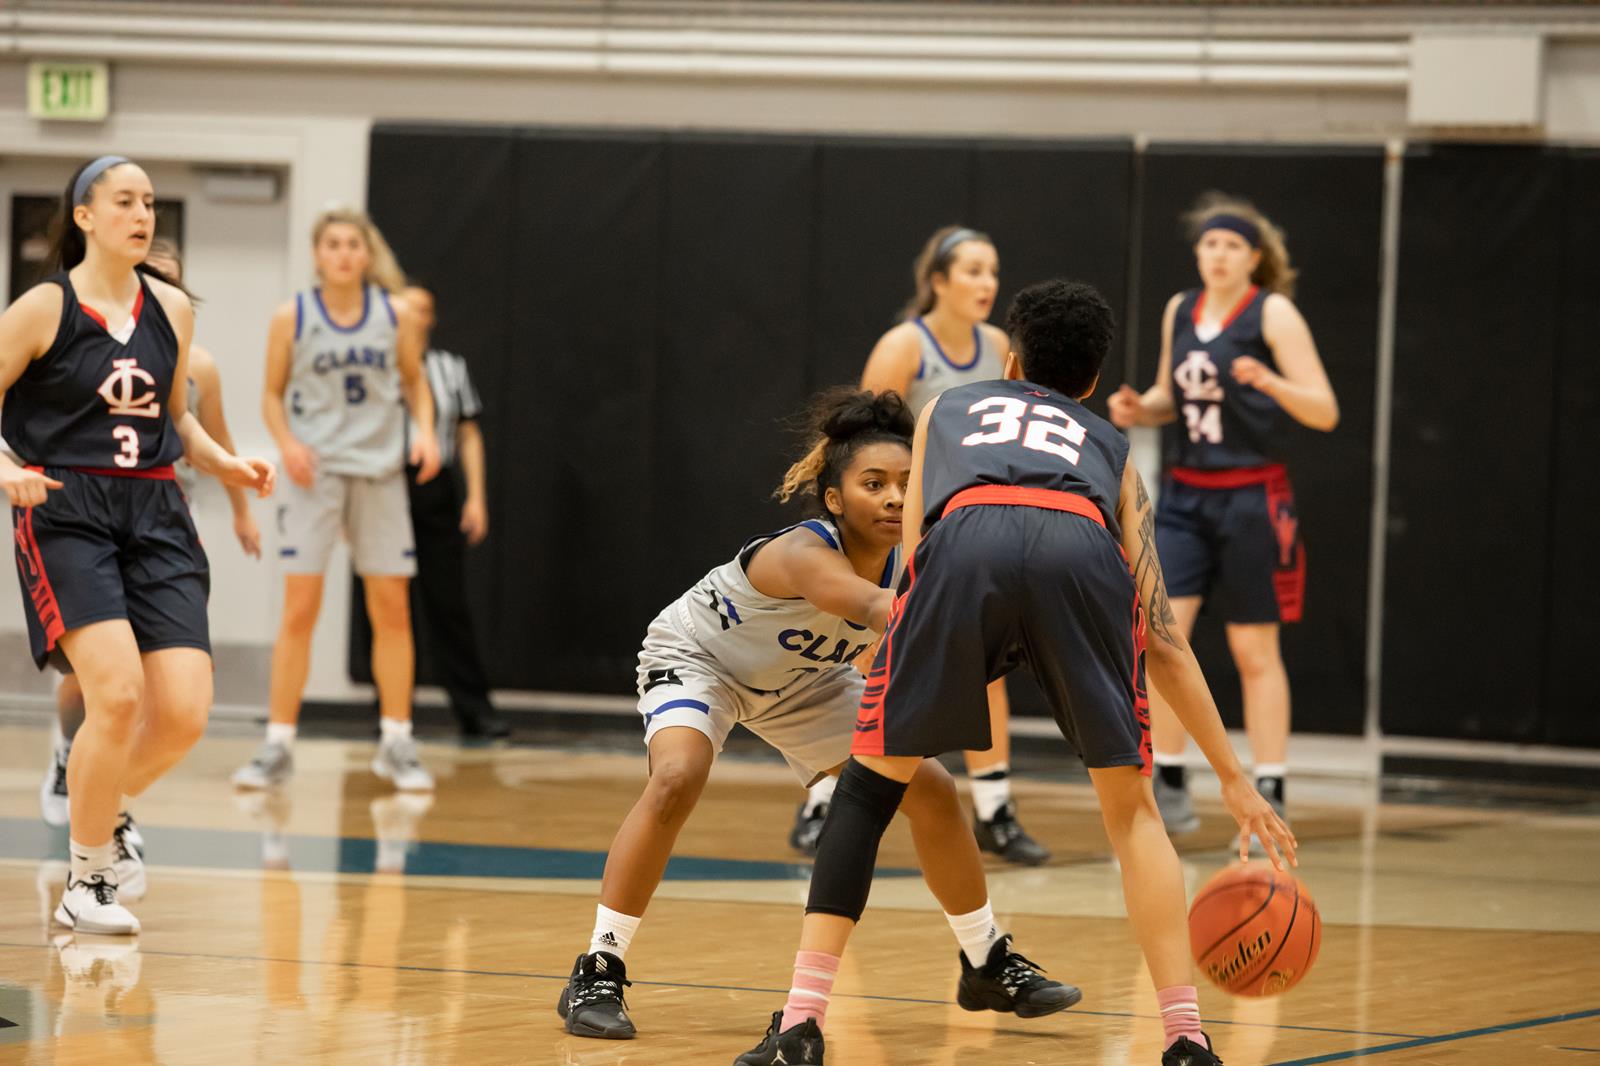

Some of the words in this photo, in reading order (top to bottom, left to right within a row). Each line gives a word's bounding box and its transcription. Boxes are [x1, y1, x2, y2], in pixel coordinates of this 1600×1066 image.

[42, 69, 92, 112] EXIT
[344, 373, 367, 405] 5
[112, 425, 139, 468] 3
[961, 396, 1087, 466] 32
[778, 629, 872, 663] CLA
